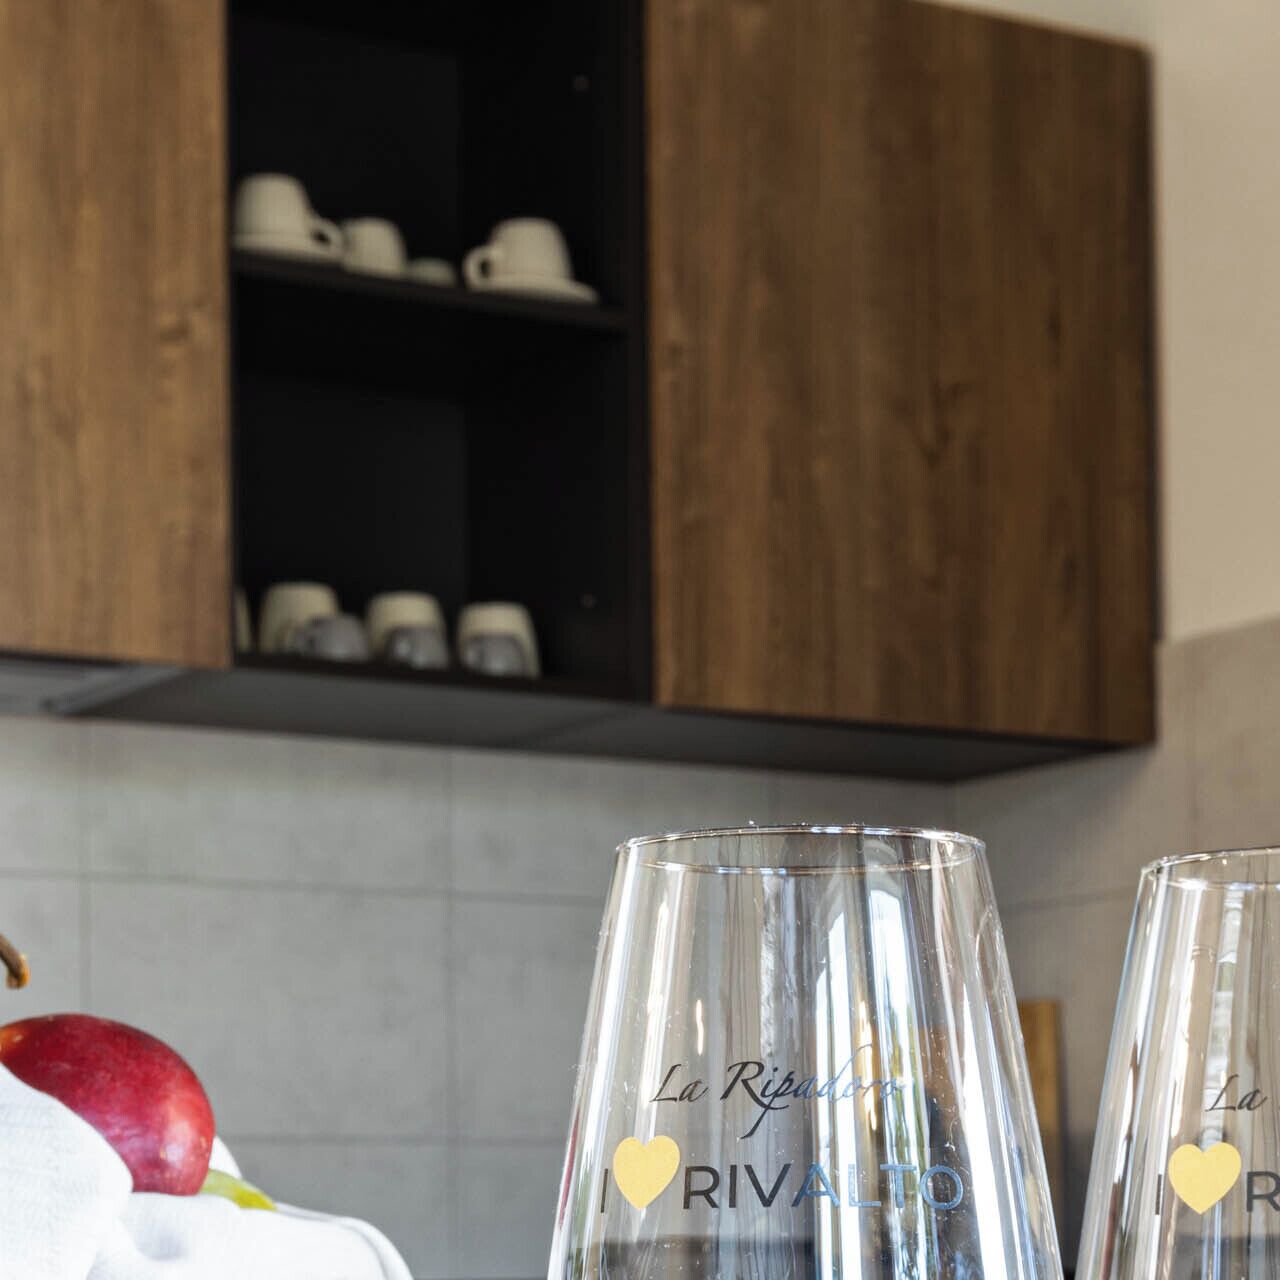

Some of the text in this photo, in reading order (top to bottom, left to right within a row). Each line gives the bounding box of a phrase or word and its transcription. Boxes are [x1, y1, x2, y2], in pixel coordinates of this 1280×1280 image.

[649, 1063, 709, 1103] La
[1206, 1073, 1268, 1112] La
[682, 1161, 965, 1210] RIVALTO
